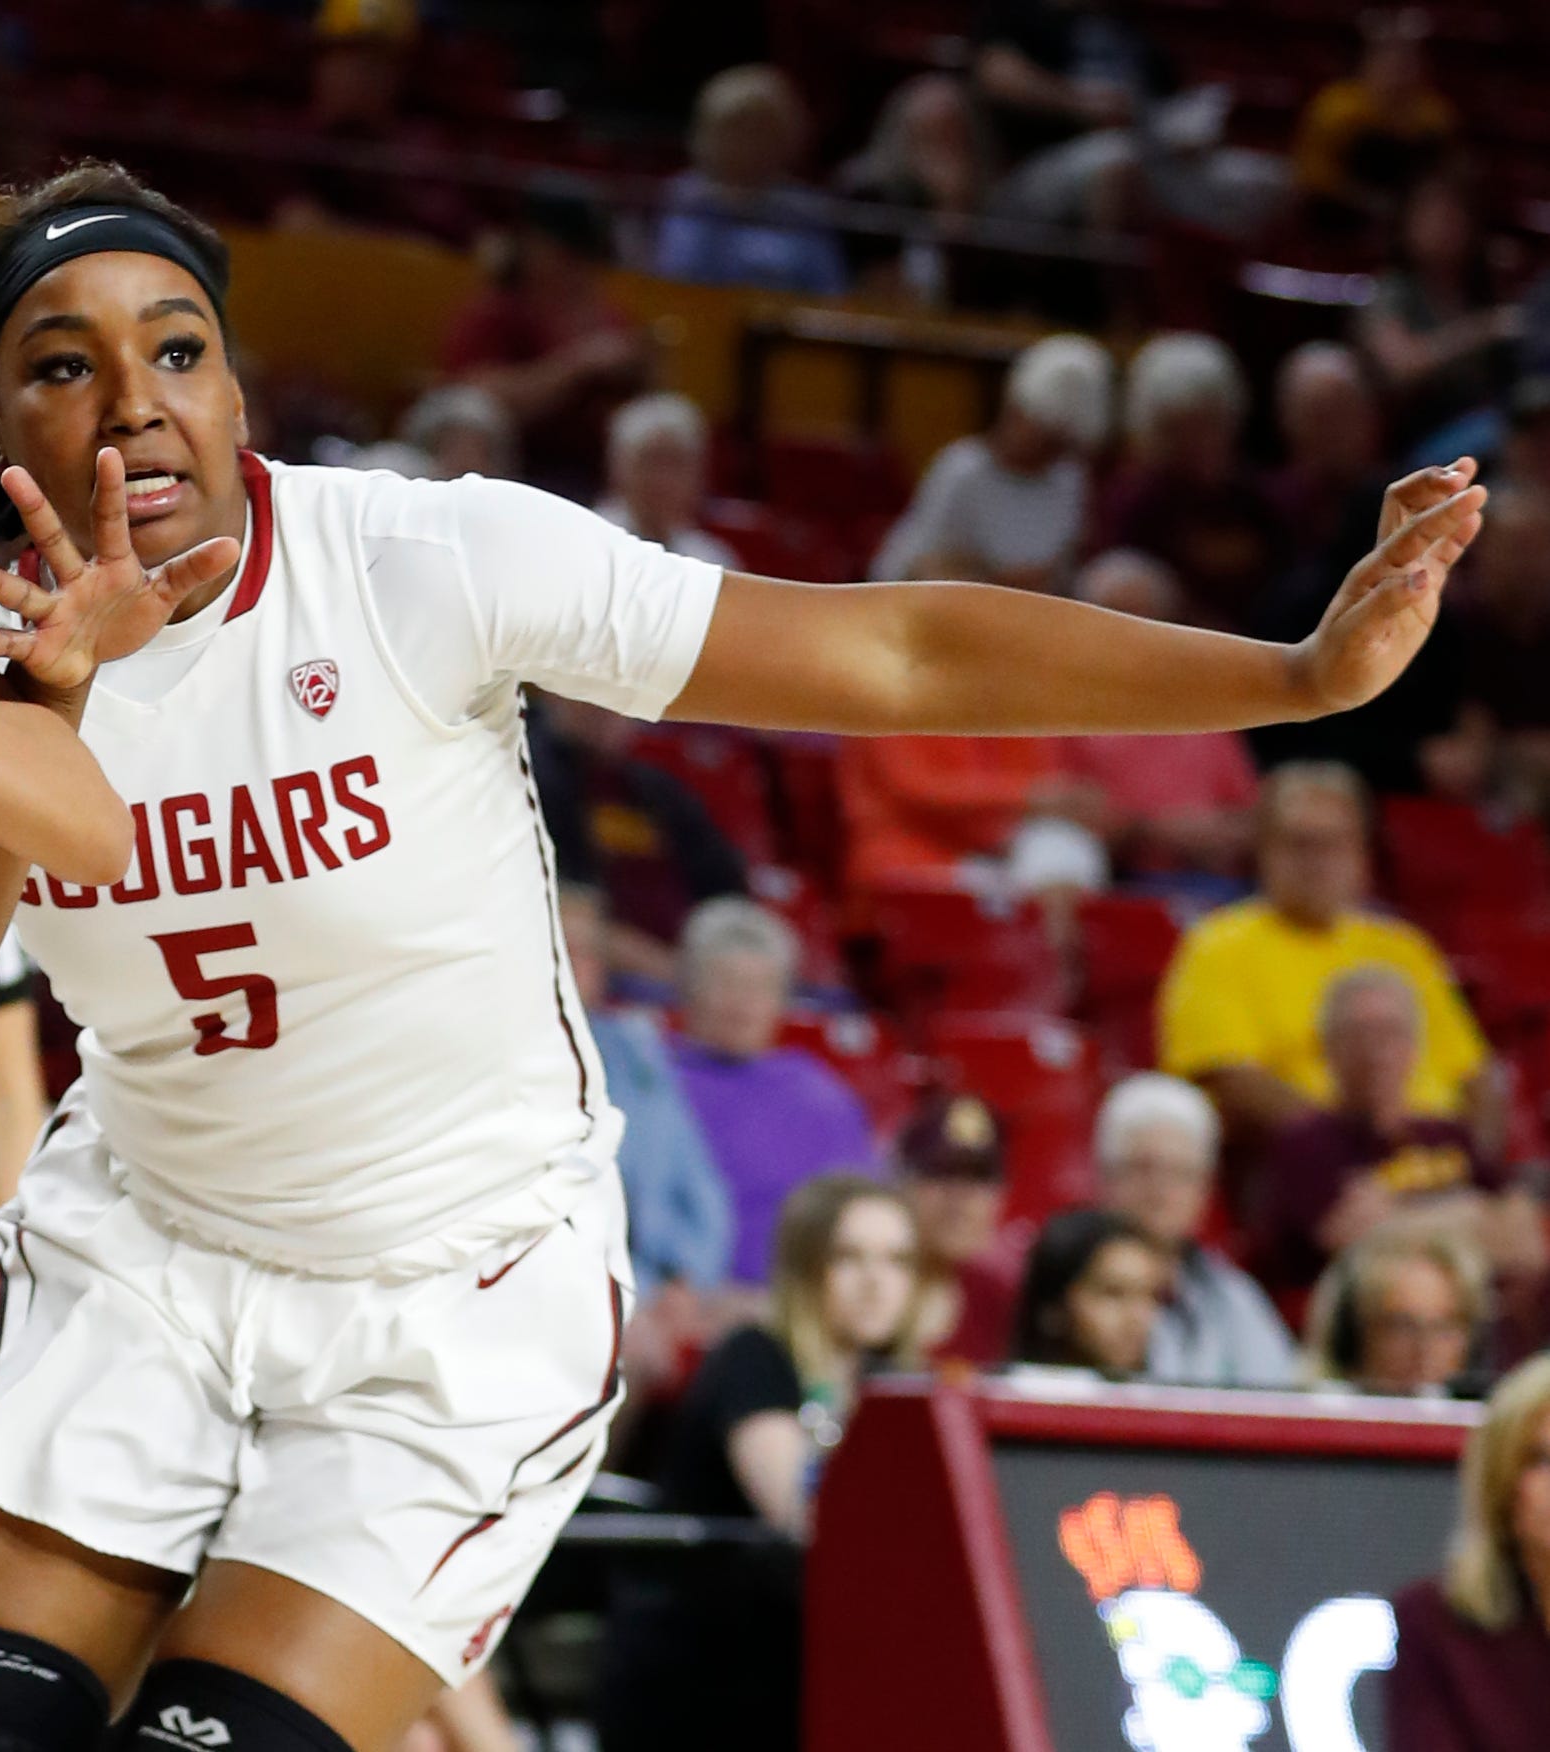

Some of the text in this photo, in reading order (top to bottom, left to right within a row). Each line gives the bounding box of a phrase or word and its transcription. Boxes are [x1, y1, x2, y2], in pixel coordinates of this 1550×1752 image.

[292, 661, 337, 700] PAC
[306, 683, 331, 709] 12
[19, 754, 391, 910] UGARS
[145, 921, 278, 1056] 5
